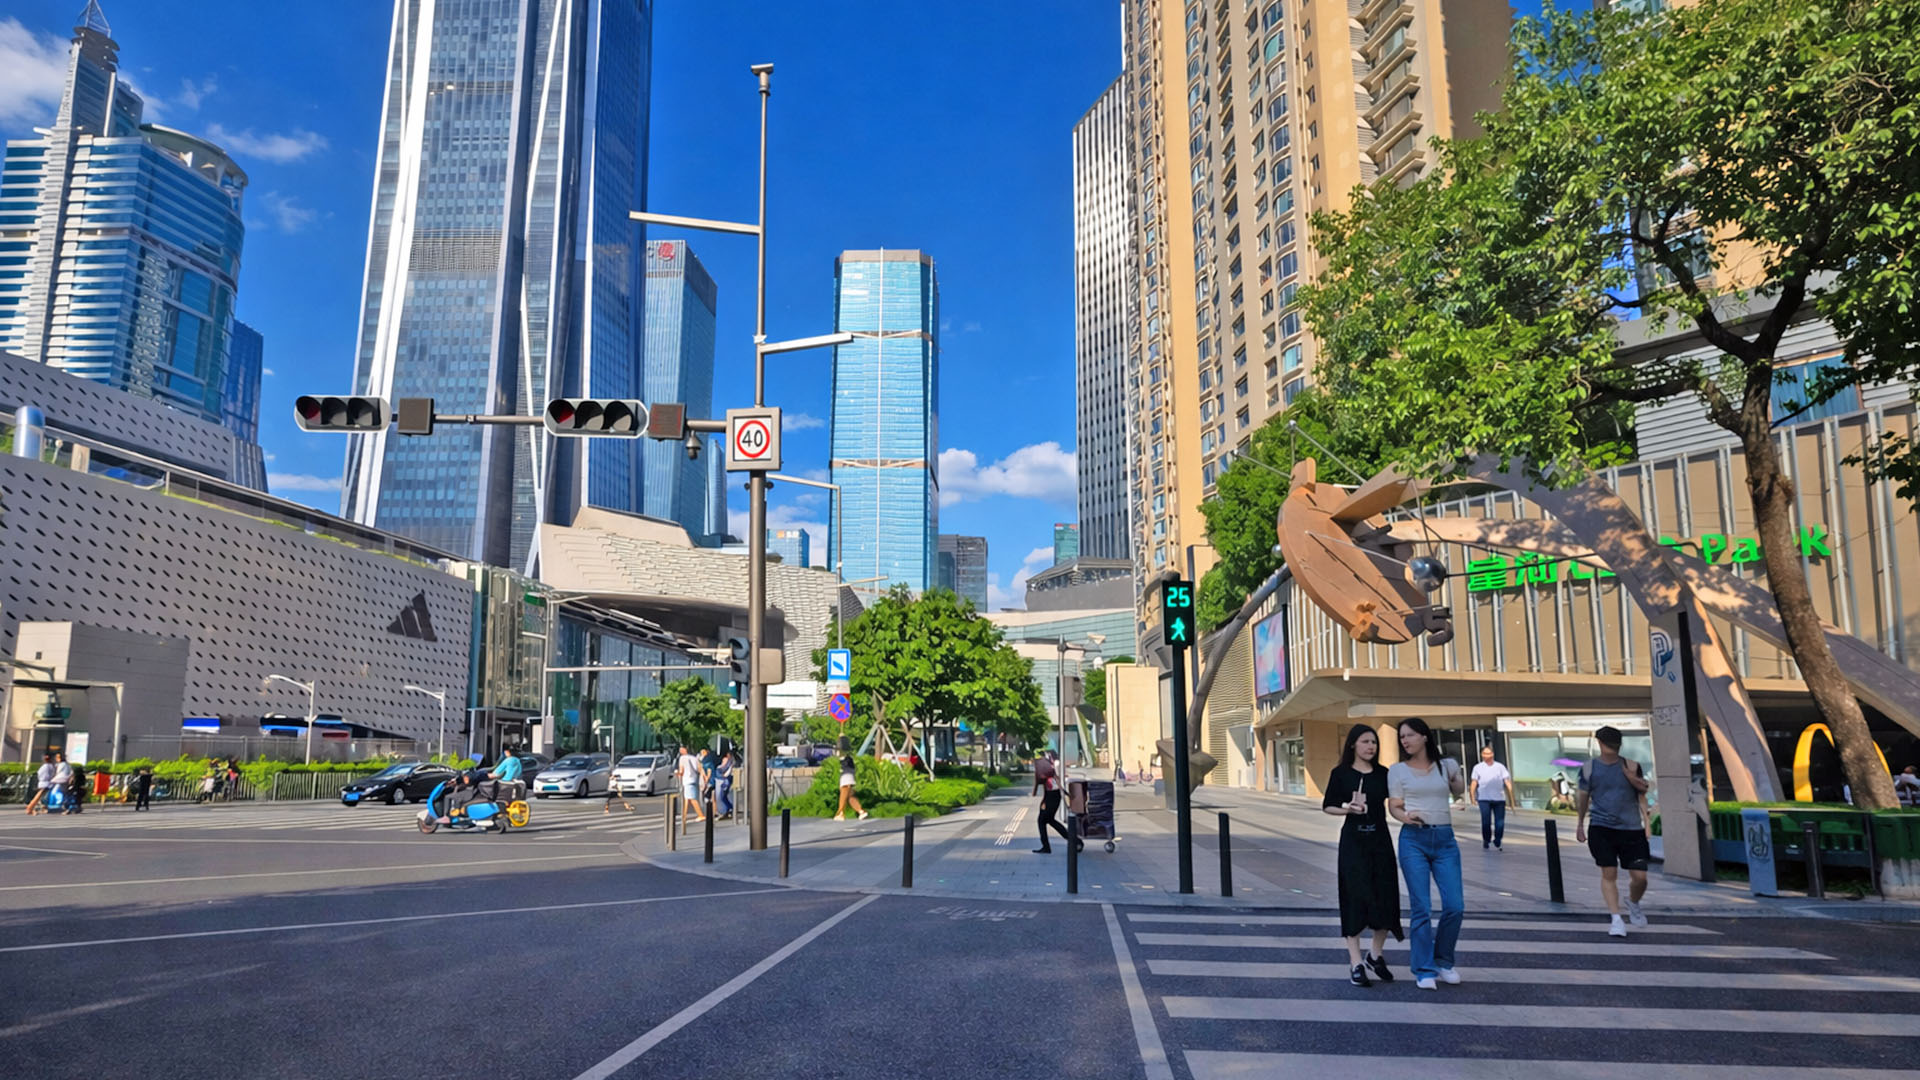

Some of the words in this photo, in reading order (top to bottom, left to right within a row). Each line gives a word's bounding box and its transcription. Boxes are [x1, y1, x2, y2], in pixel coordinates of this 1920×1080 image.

[742, 429, 763, 447] 40
[1701, 523, 1832, 565] Pak
[1167, 586, 1190, 608] 25
